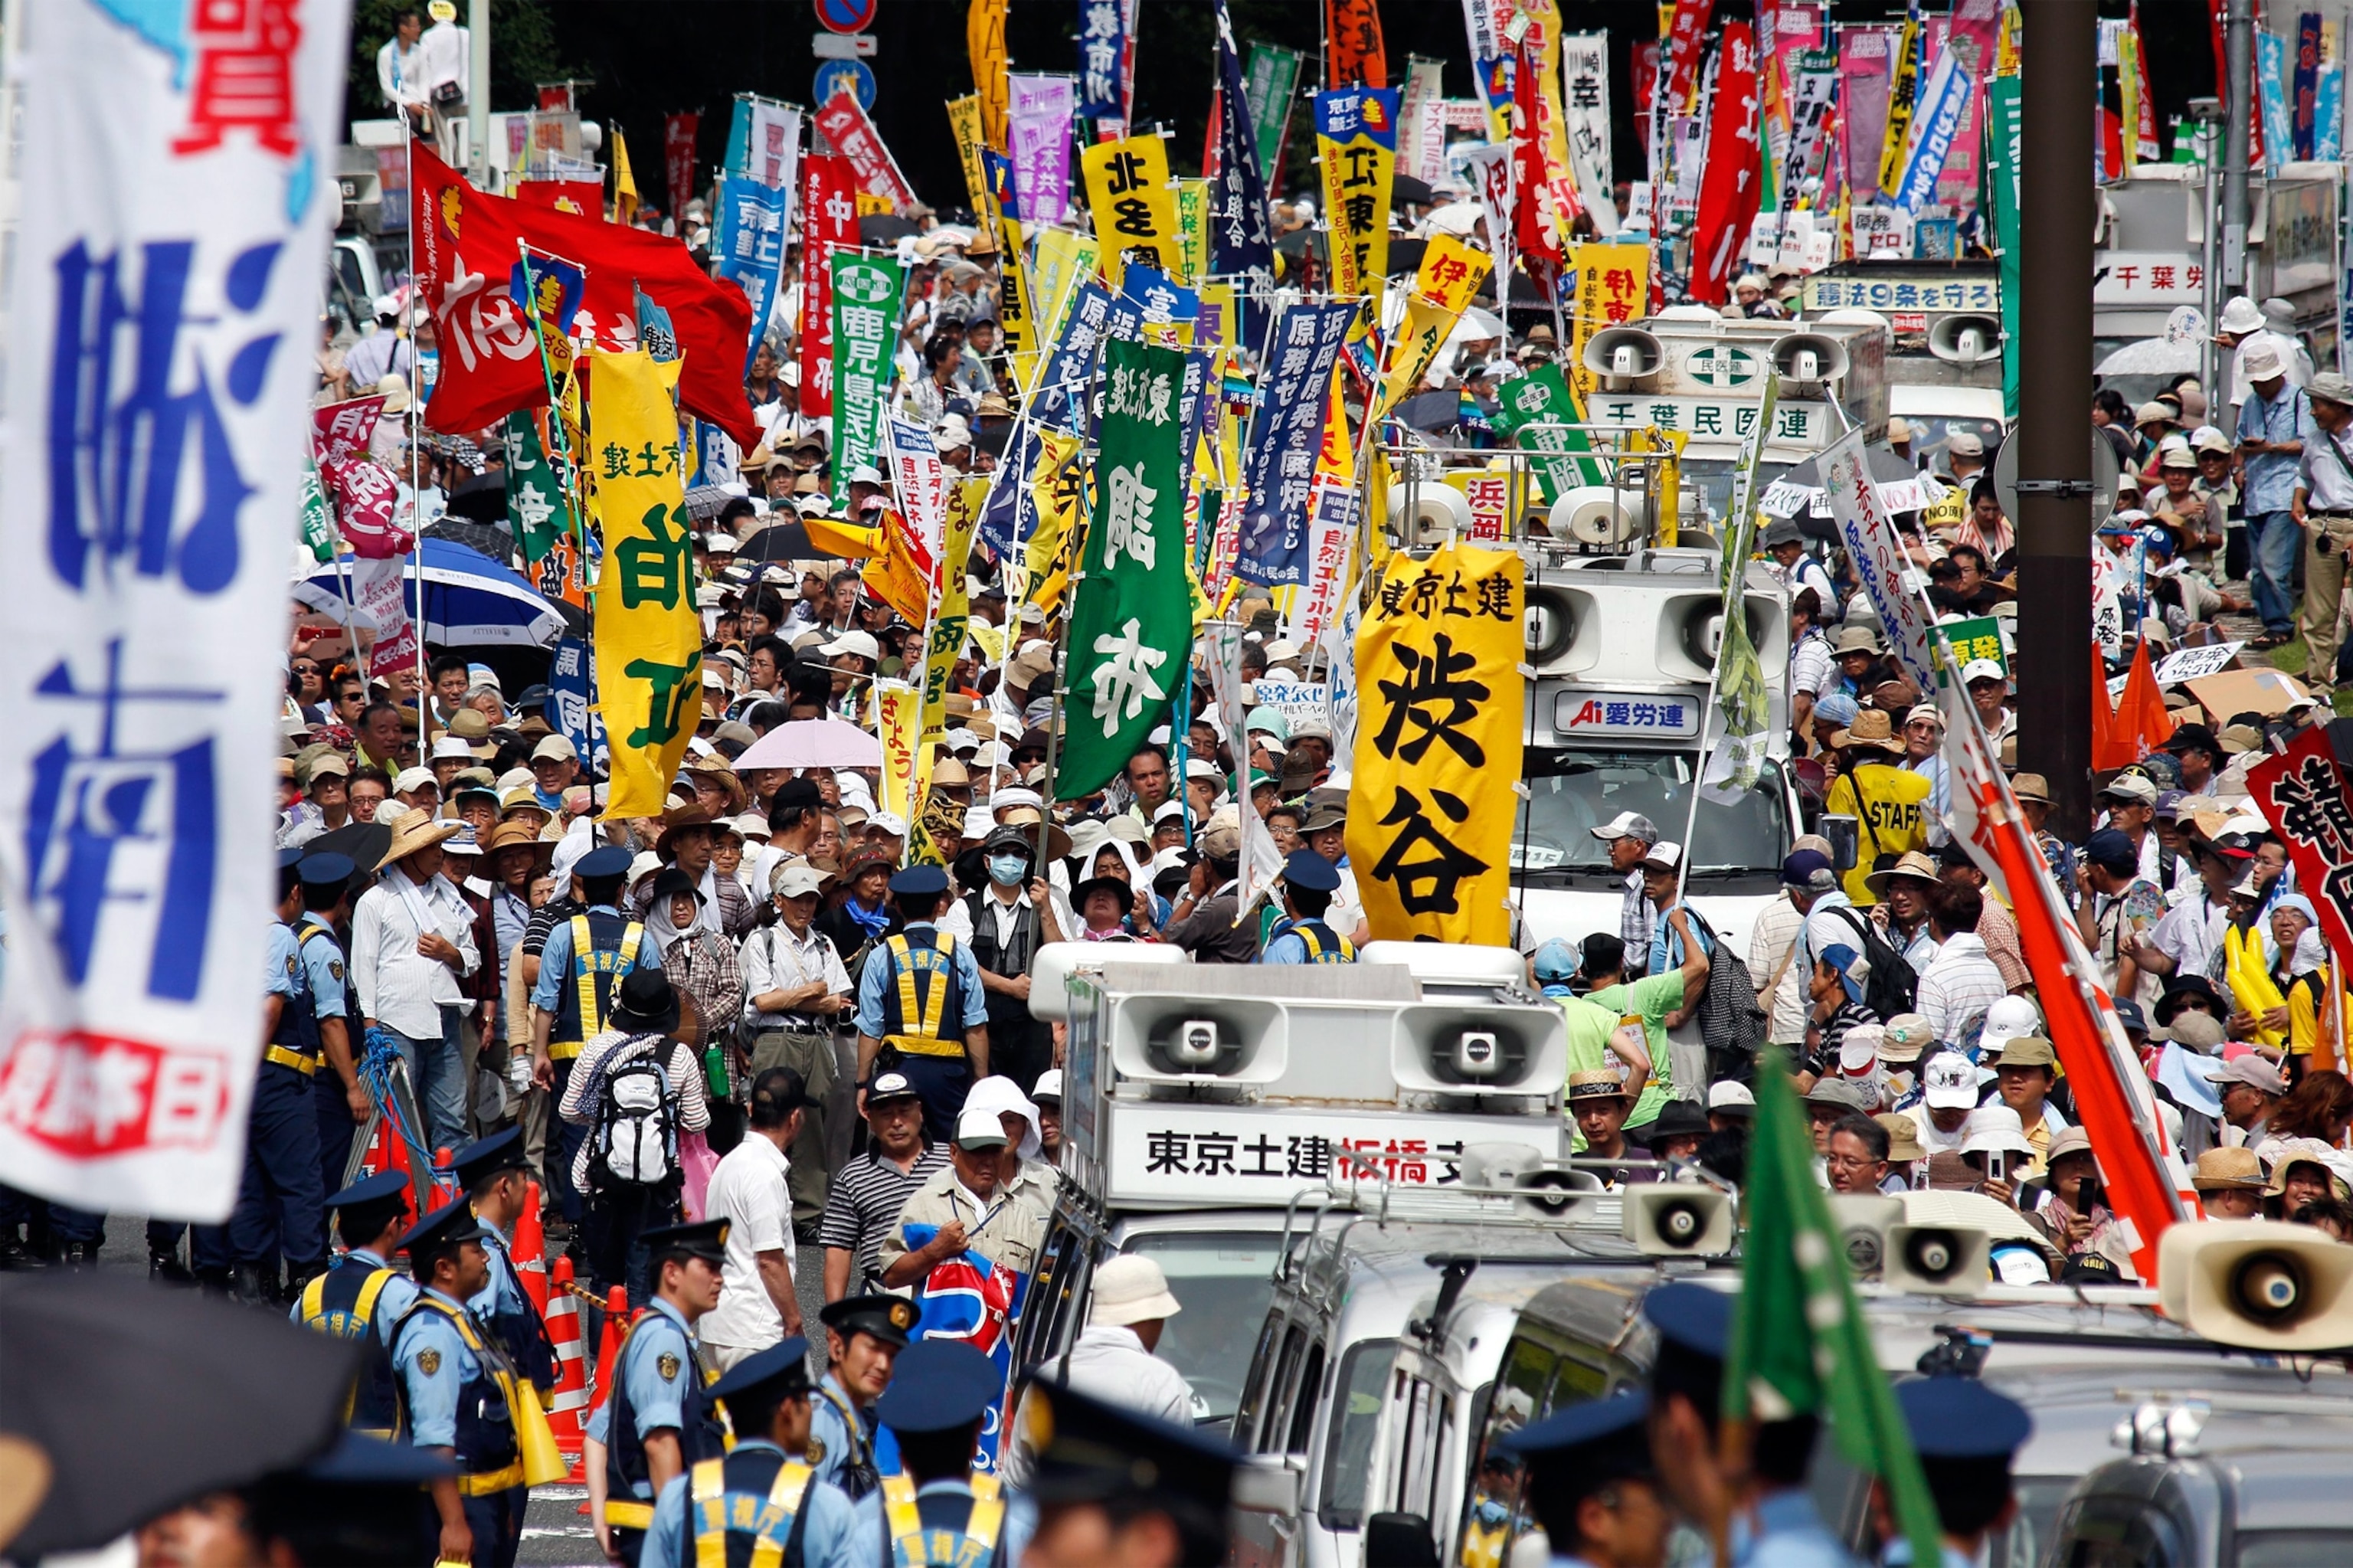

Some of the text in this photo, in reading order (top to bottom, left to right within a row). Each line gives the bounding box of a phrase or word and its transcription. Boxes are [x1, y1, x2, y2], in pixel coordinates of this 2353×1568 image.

[1701, 358, 1743, 374] 民医連
[1606, 401, 1810, 440] 千葉民医連
[1376, 568, 1515, 624] 東京土建
[1605, 701, 1684, 728] 愛労連
[1370, 631, 1493, 917] 渋谷
[1870, 797, 1923, 832] STAFF
[898, 950, 944, 971] 警視庁
